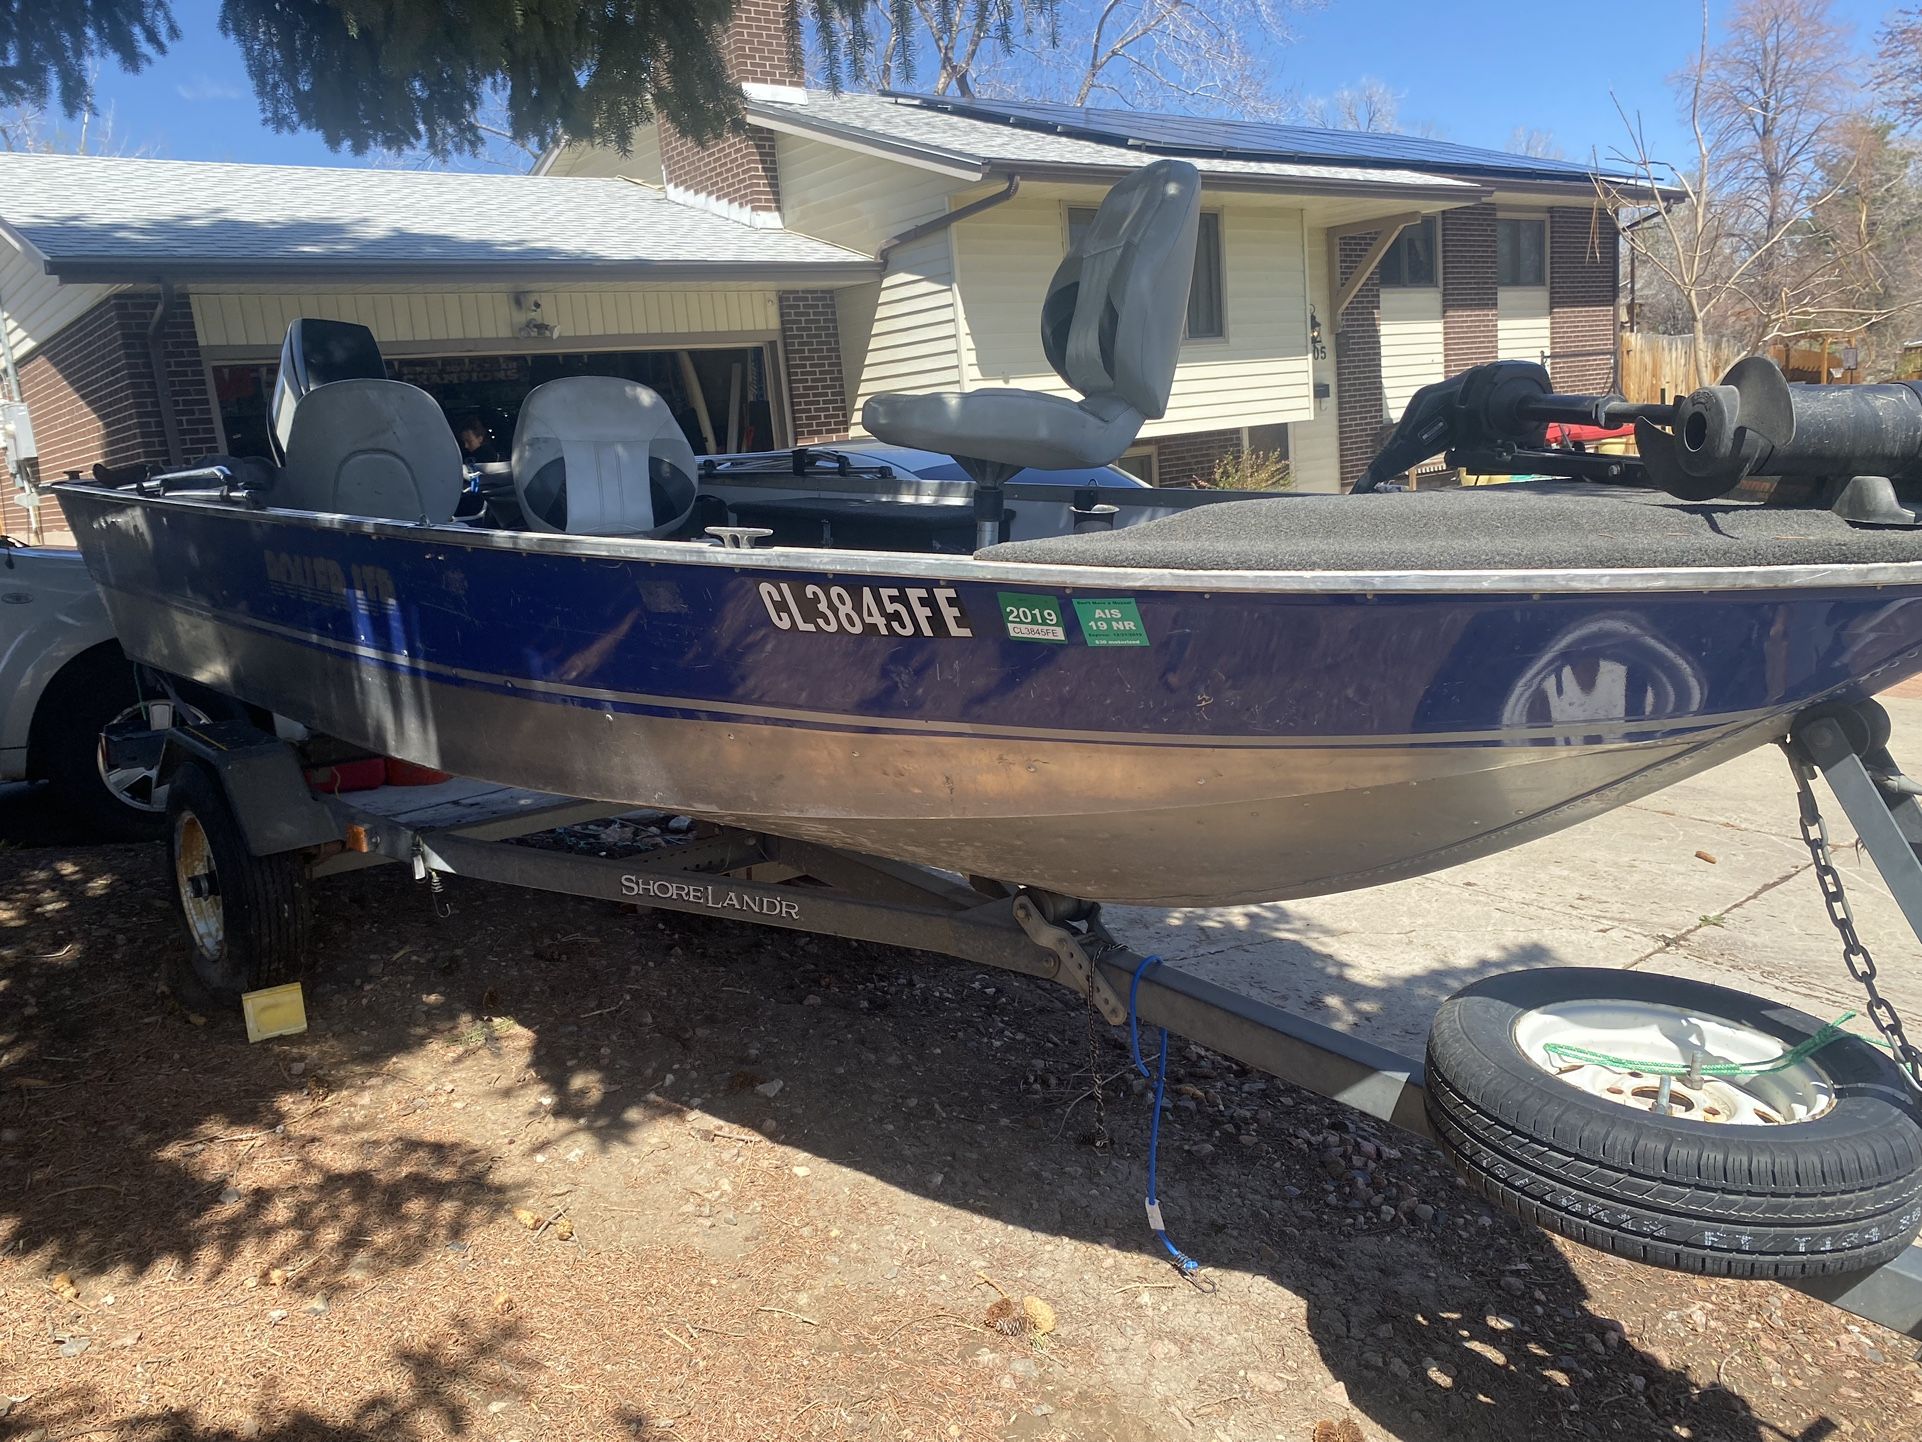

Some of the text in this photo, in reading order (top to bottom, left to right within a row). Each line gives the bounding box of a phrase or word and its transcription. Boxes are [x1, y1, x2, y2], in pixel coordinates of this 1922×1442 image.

[757, 581, 974, 638] CL3845FE
[1095, 609, 1122, 618] AIS
[1006, 606, 1057, 625] 2019
[1088, 621, 1137, 630] 19 NR
[1012, 626, 1059, 637] CL3845FE
